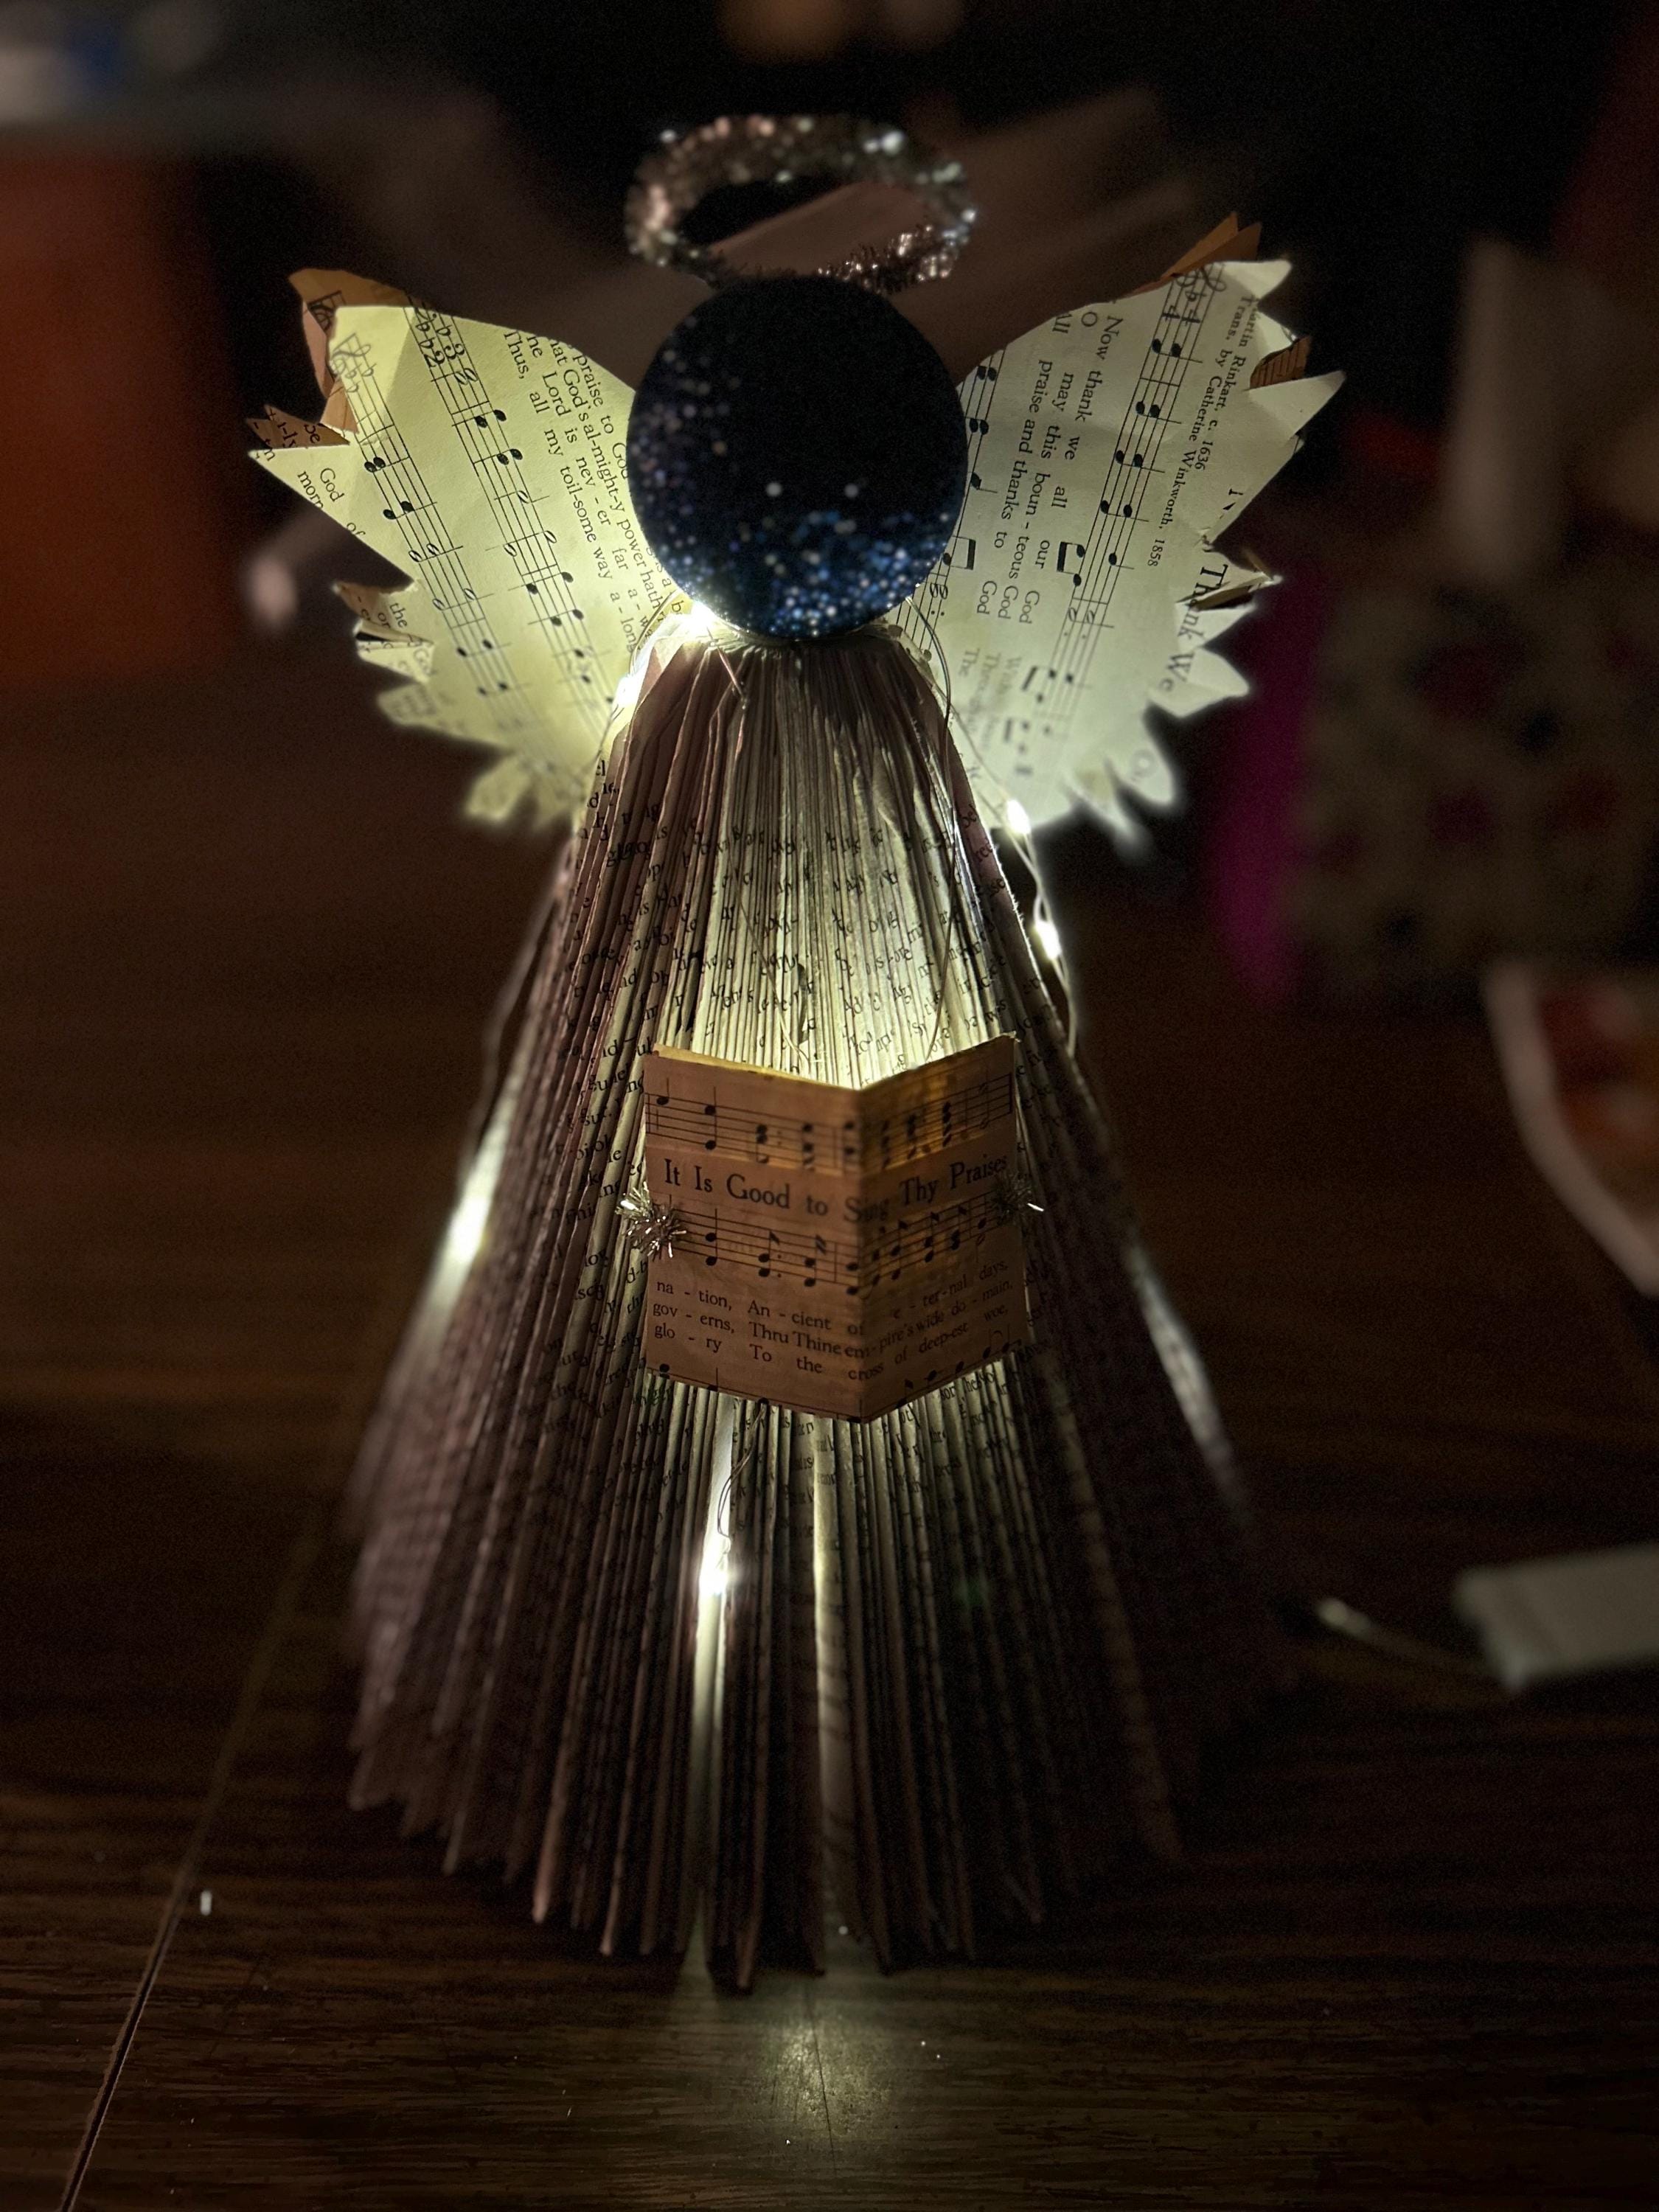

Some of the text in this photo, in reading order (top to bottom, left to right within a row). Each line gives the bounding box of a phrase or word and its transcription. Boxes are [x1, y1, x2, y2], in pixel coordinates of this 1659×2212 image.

[1081, 311, 1099, 327] O
[1214, 355, 1247, 411] Rinkart,
[1215, 348, 1232, 367] by
[572, 355, 603, 407] praise
[600, 414, 614, 434] to
[1029, 359, 1053, 413] praise
[1051, 372, 1075, 412] may
[1189, 375, 1222, 442] Catherine
[1018, 418, 1036, 454] and
[1040, 425, 1062, 459] this
[1207, 420, 1218, 431] c.
[504, 331, 529, 380] Thus,
[529, 392, 550, 414] all
[544, 429, 564, 456] my
[560, 466, 597, 543] toil-some
[593, 546, 613, 580] way
[610, 592, 619, 602] a
[1019, 315, 1124, 625] Now thank we all our God
[1194, 442, 1214, 470] 1636
[542, 371, 571, 417] Lord
[564, 428, 577, 443] is
[576, 456, 596, 487] nev
[597, 509, 611, 526] er
[612, 547, 629, 570] far
[627, 588, 638, 599] a
[1001, 460, 1028, 520] thanks
[1025, 471, 1051, 516] boun
[1158, 449, 1197, 529] Winkworth,
[319, 467, 345, 503] God
[389, 602, 408, 627] the
[616, 518, 647, 569] power
[640, 569, 664, 610] hath
[993, 531, 1008, 549] to
[1008, 535, 1030, 580] teous
[1147, 538, 1165, 567] 1858
[976, 580, 998, 615] God
[998, 585, 1019, 619] God
[664, 1158, 681, 1186] It
[694, 1165, 713, 1193] Is
[726, 1173, 791, 1210] Good
[806, 1194, 830, 1217] to
[899, 1177, 939, 1206] Thy
[949, 1154, 1008, 1189] Praises
[652, 1302, 678, 1318] gov
[700, 1315, 735, 1335] erns,
[748, 1321, 790, 1344] Thru
[793, 1330, 842, 1355] Thine
[916, 1312, 945, 1333] wide
[951, 1300, 967, 1316] do
[656, 1281, 674, 1295] na
[698, 1290, 732, 1311] tion,
[747, 1300, 771, 1318] An
[791, 1311, 832, 1330] cient
[654, 1323, 675, 1340] glo
[705, 1337, 723, 1354] ry
[749, 1343, 773, 1363] To
[796, 1357, 823, 1374] the
[848, 1364, 884, 1381] cross
